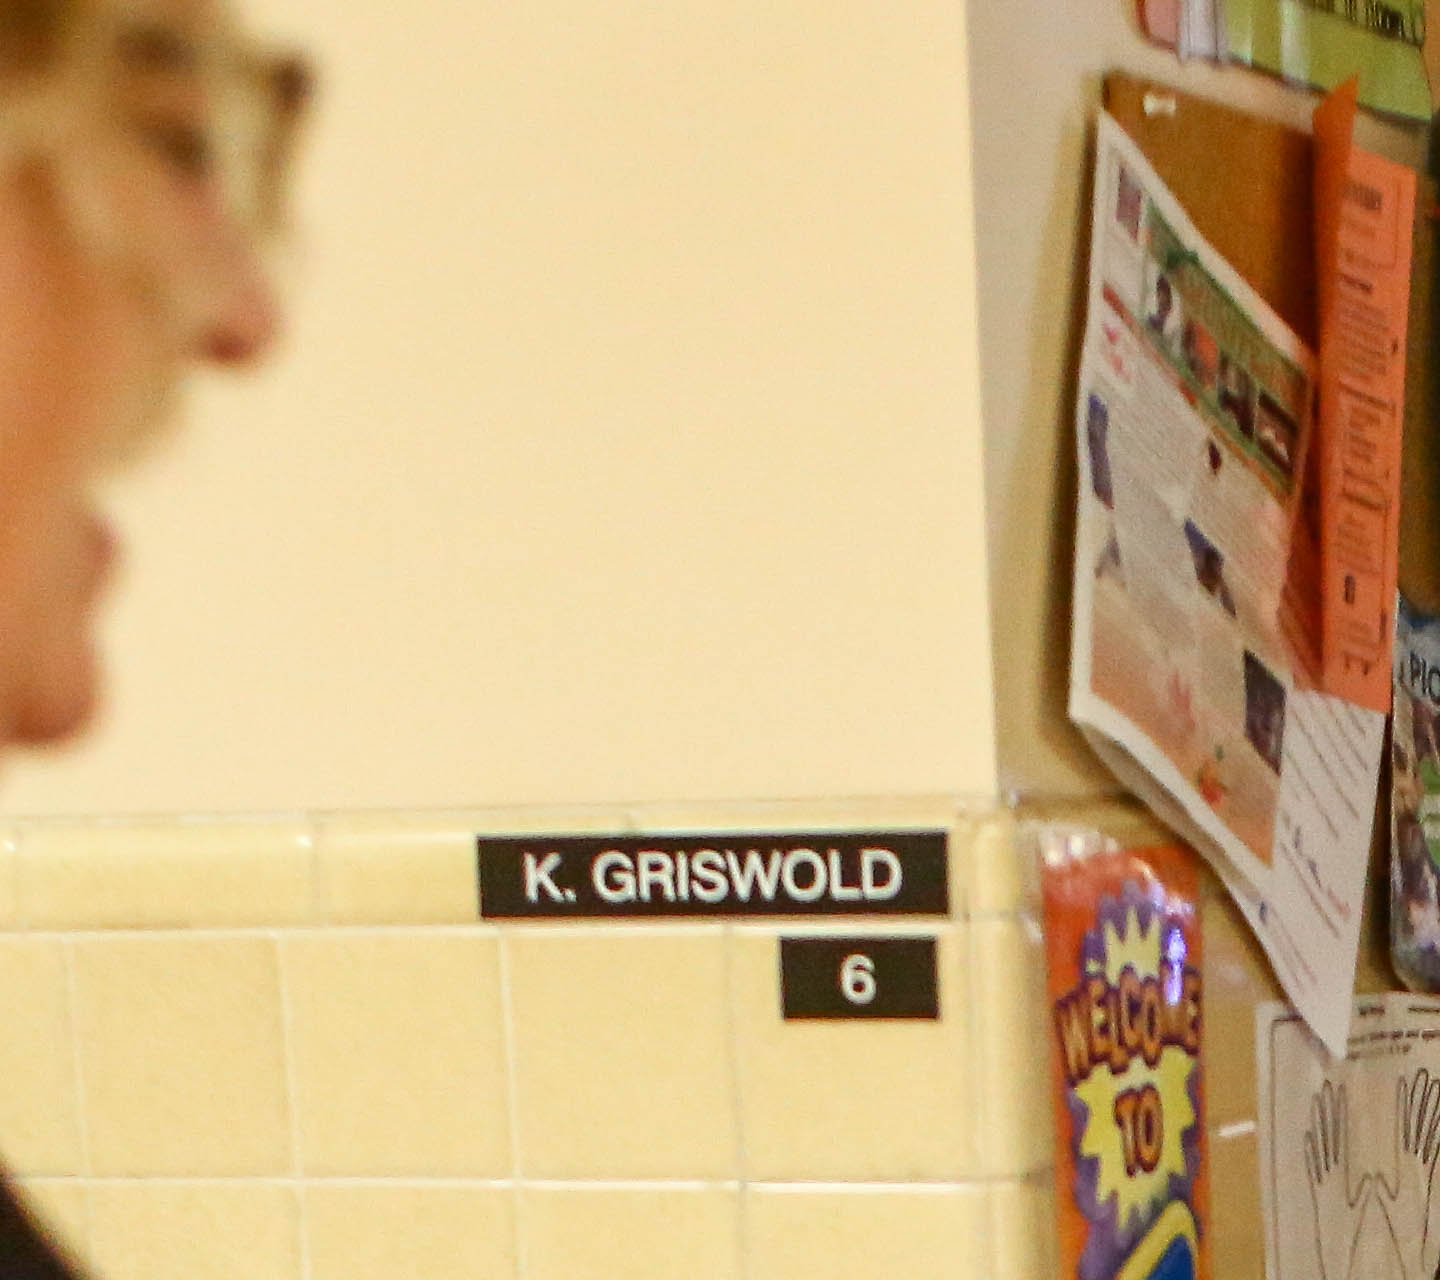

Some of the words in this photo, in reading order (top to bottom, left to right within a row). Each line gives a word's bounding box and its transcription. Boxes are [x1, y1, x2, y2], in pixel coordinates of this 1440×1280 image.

[523, 850, 577, 902] K.
[591, 847, 904, 902] GRISWOLD
[839, 954, 877, 1005] 6
[1114, 1082, 1164, 1178] TO
